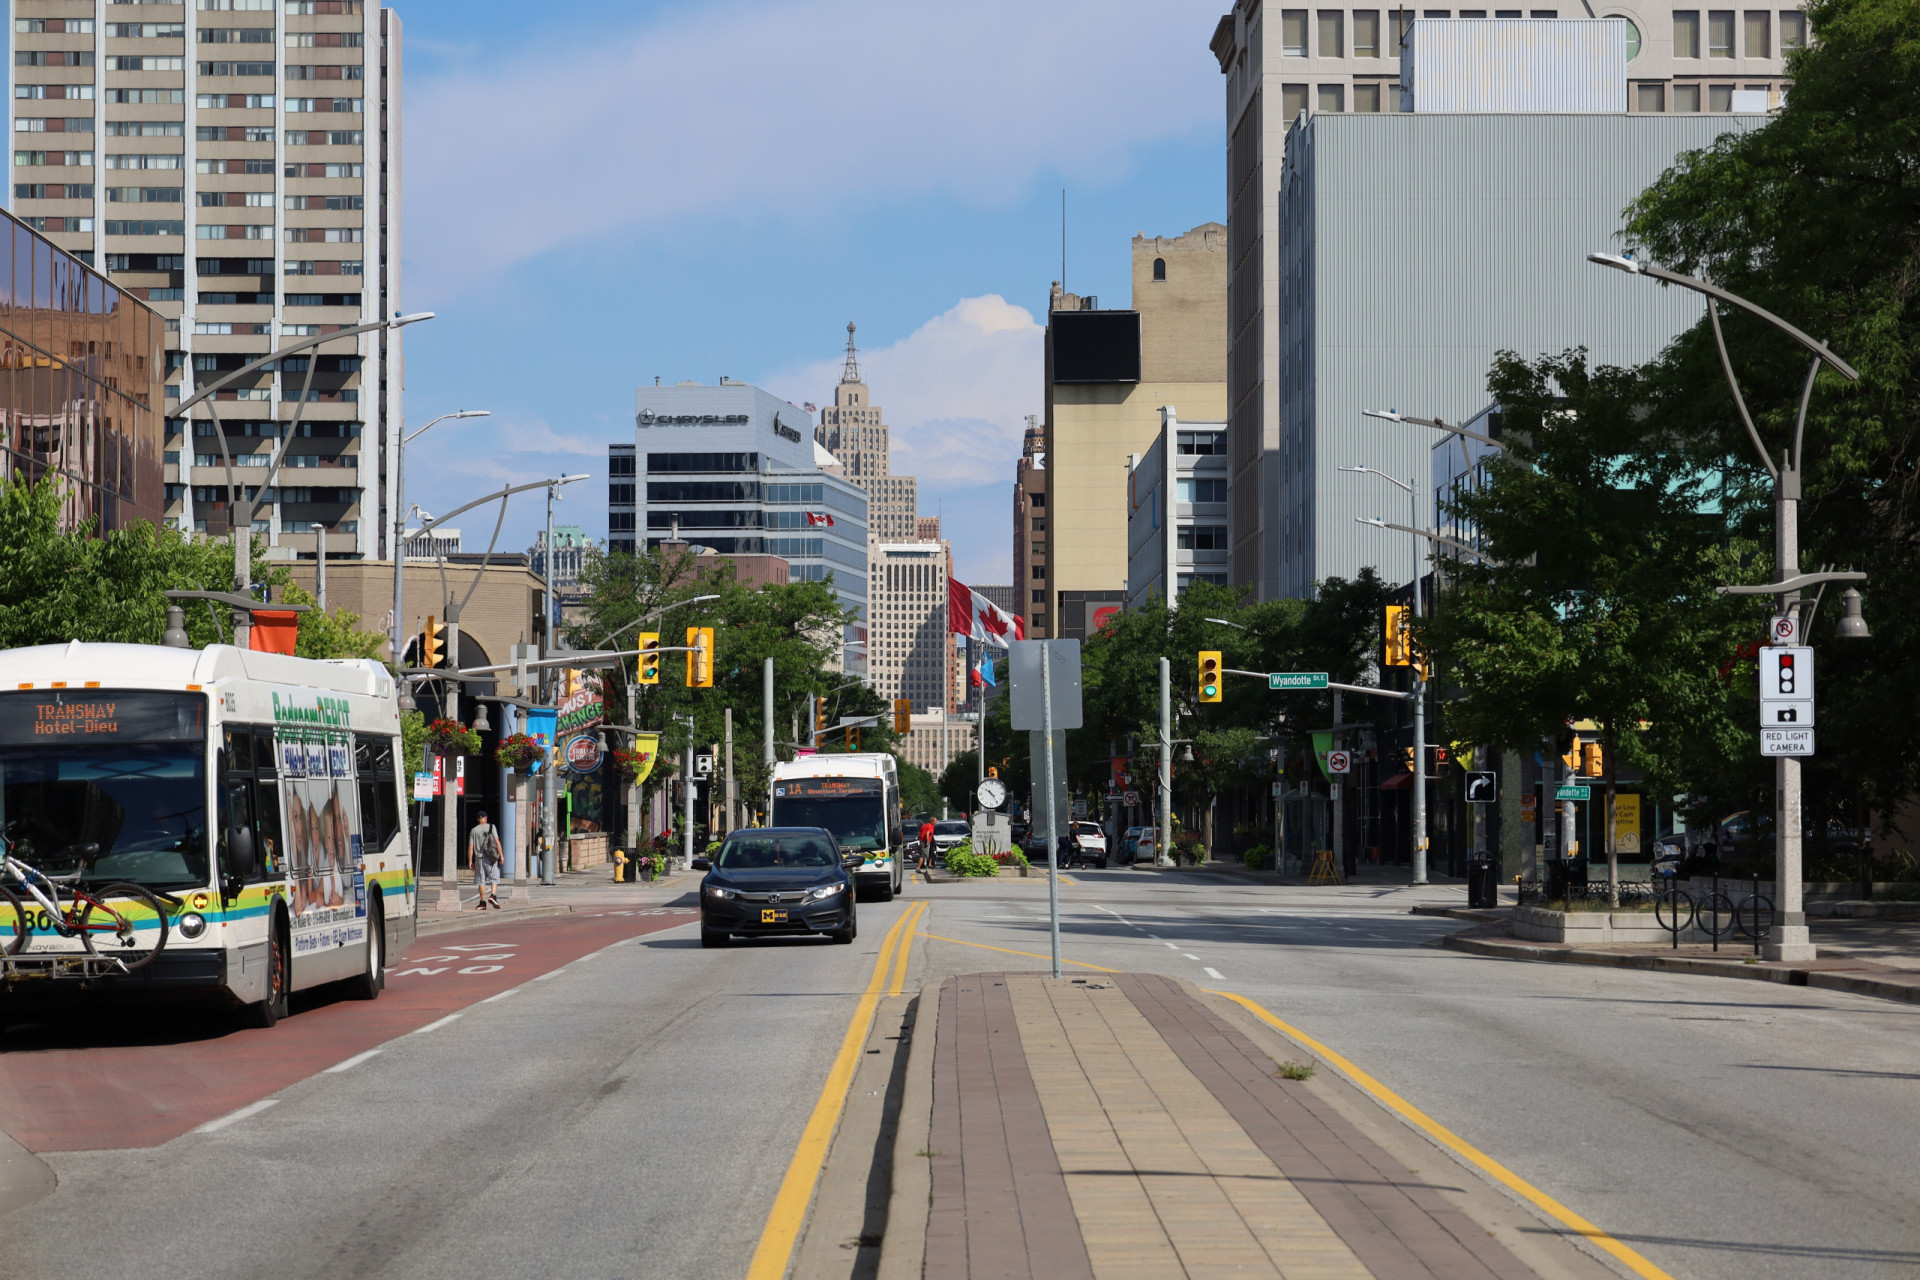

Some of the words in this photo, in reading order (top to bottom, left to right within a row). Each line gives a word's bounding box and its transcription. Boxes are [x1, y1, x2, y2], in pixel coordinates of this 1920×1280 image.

[656, 414, 749, 425] CHRYSLER
[1272, 675, 1311, 687] Wyandotte
[558, 691, 594, 717] MUST
[36, 703, 116, 720] TRANSWAY
[35, 719, 118, 734] Hotel-Dieu
[1766, 732, 1782, 741] RED
[1785, 732, 1809, 741] LIGHT
[1770, 743, 1806, 752] CAMERA
[789, 783, 802, 795] 1A
[1555, 788, 1580, 798] yandotte
